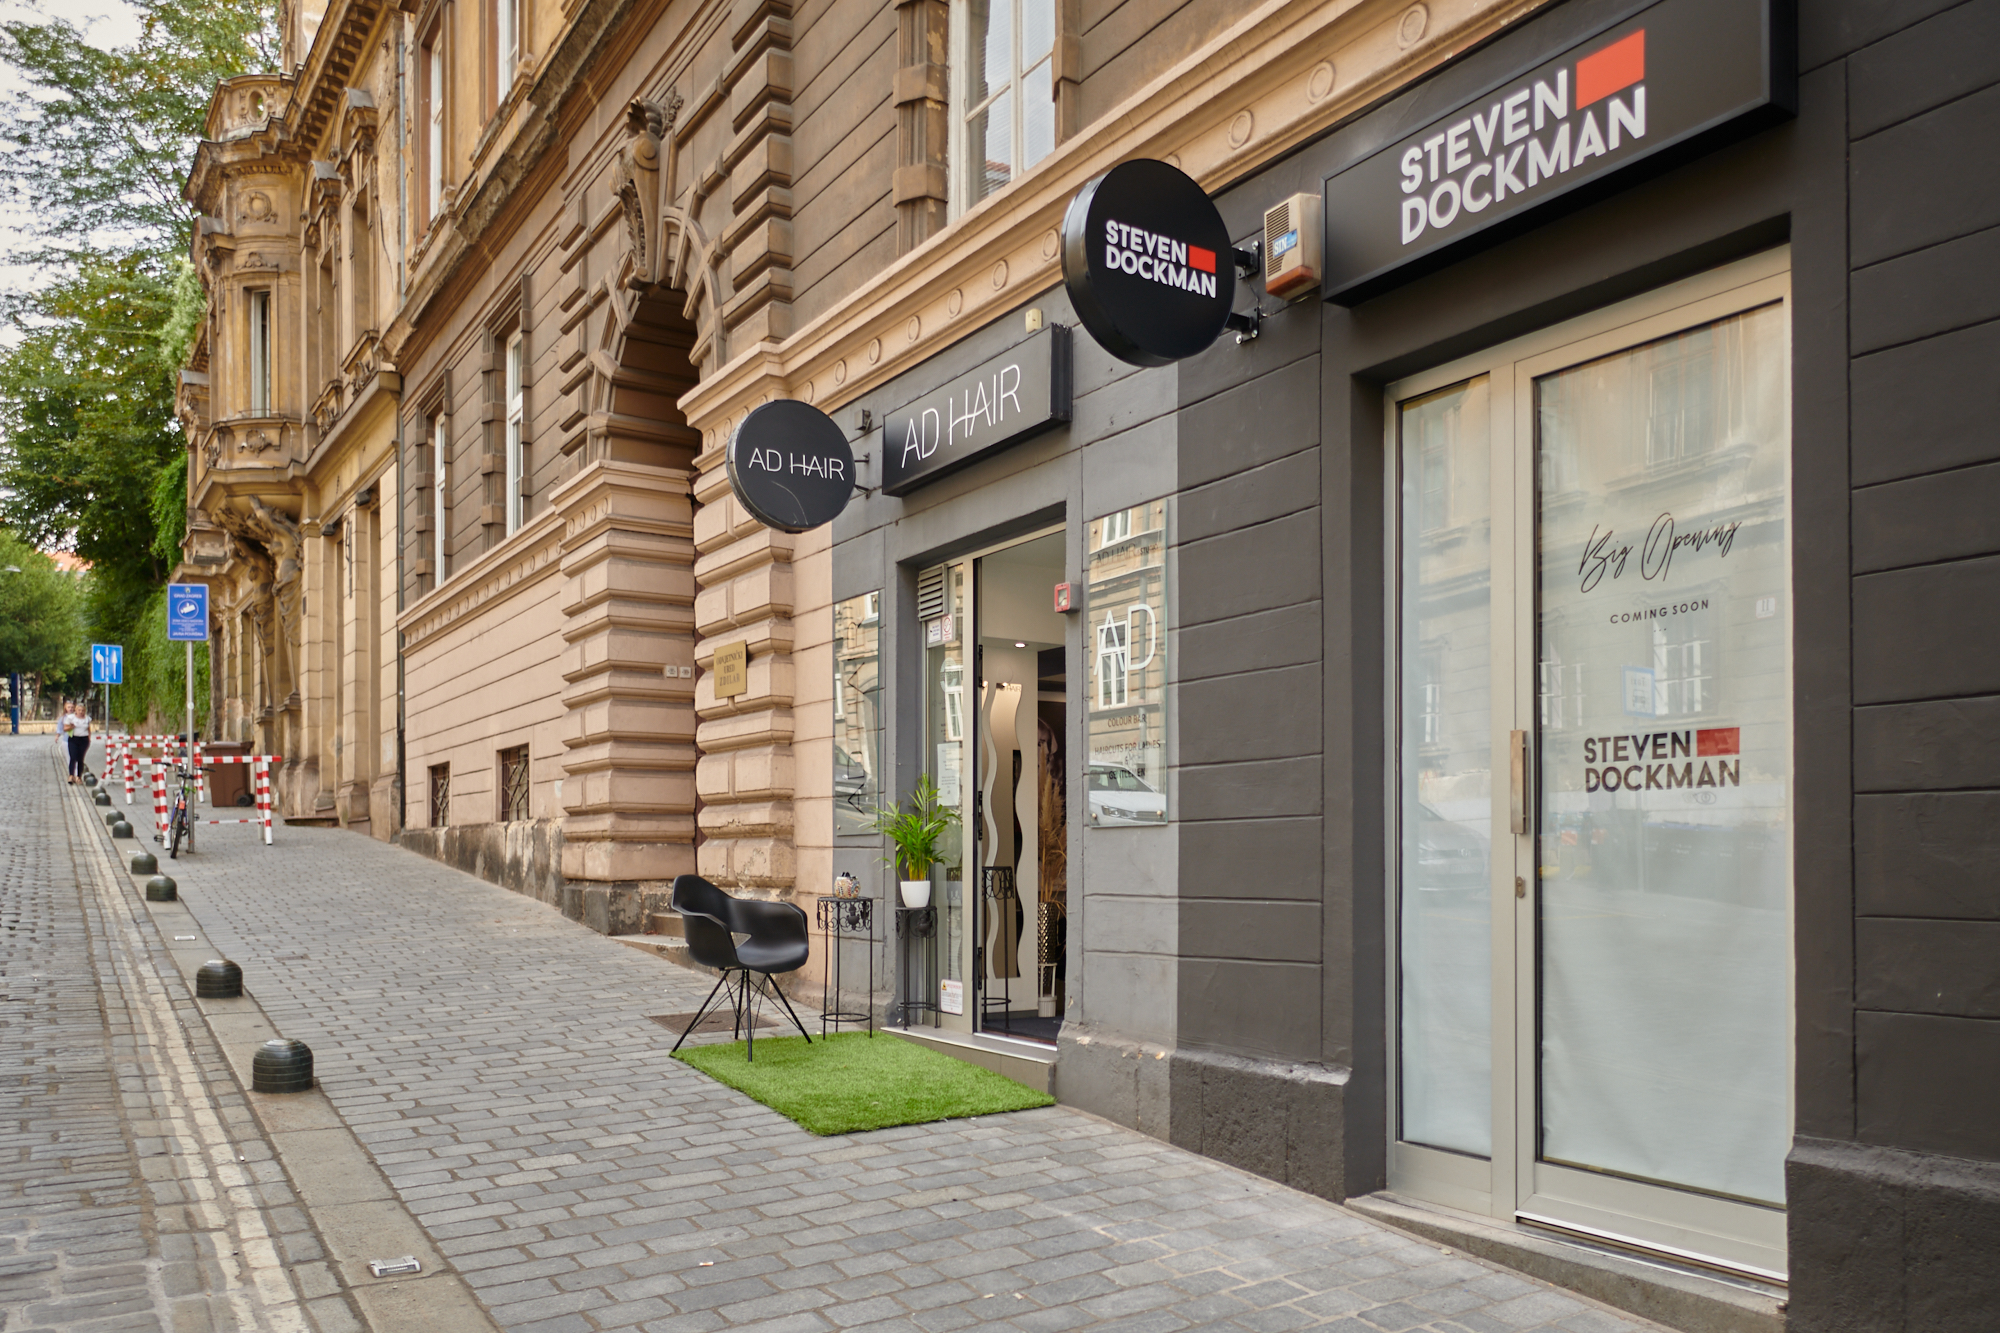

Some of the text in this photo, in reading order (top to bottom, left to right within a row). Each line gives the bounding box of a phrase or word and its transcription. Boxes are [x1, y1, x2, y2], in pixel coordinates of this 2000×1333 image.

[1401, 68, 1567, 194] STEVEN
[1402, 86, 1645, 245] DOCKMAN
[1106, 220, 1186, 265] STEVEN
[1106, 245, 1216, 298] DOCKMAN
[901, 364, 1020, 468] AD HAIR
[748, 447, 845, 481] AD HAIR
[1578, 512, 1742, 593] Big Opening
[1610, 599, 1709, 624] COMING SOON
[1094, 604, 1156, 675] AD
[1107, 713, 1146, 728] COLOUR BAR
[1094, 739, 1160, 755] HAIRCUTS FOR LADIES
[1584, 731, 1690, 763] STEVEN
[1108, 767, 1146, 780] GETLEEN
[1585, 759, 1740, 793] DOCKMAN
